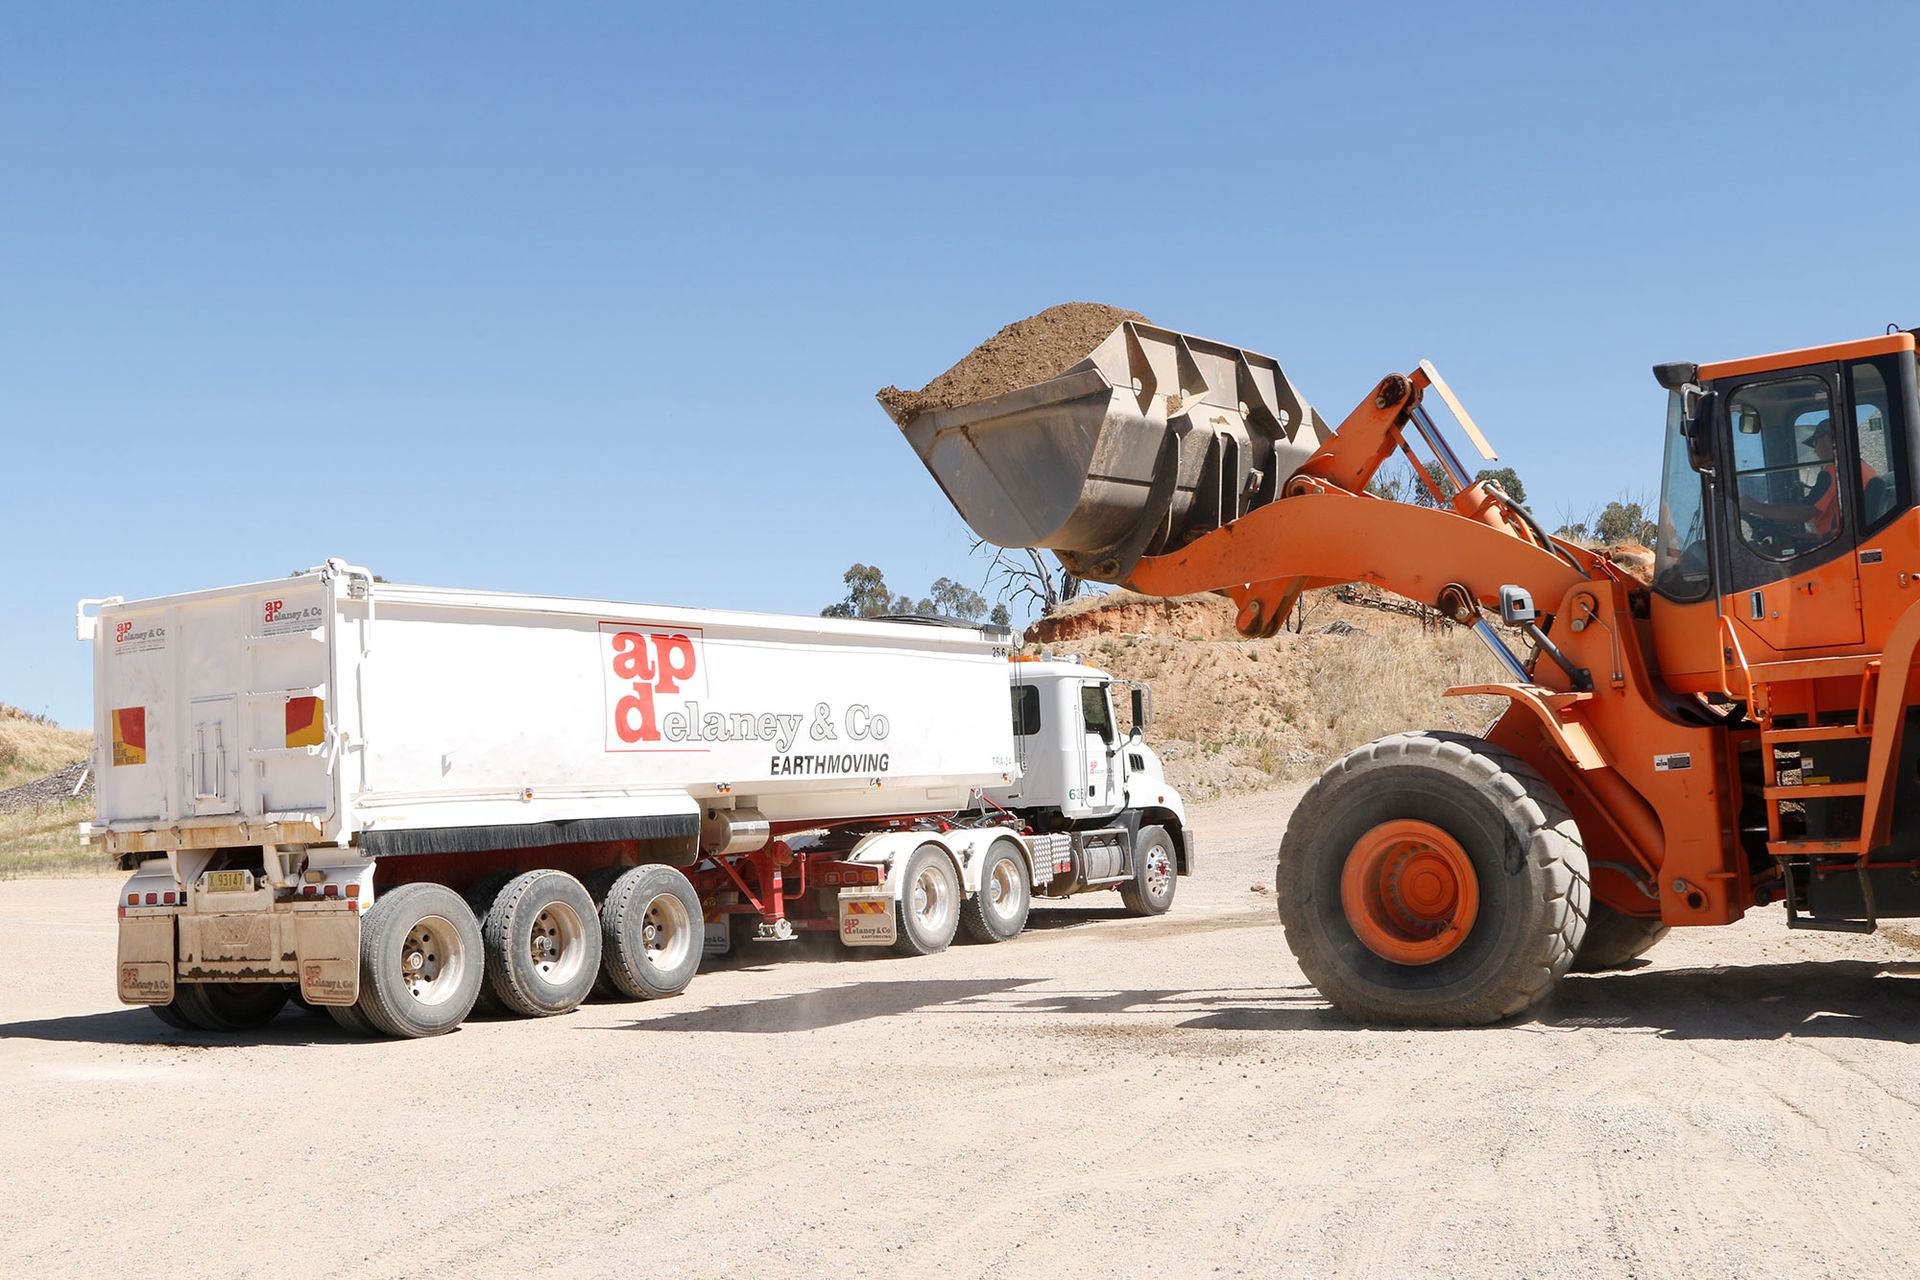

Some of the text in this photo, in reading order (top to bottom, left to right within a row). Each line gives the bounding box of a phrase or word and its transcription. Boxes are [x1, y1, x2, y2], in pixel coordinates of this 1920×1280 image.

[265, 600, 283, 613] ap
[117, 622, 132, 633] ap
[611, 631, 697, 694] ap
[809, 702, 838, 741] &
[845, 703, 890, 741] Co
[770, 753, 890, 776] EARTHMOVING
